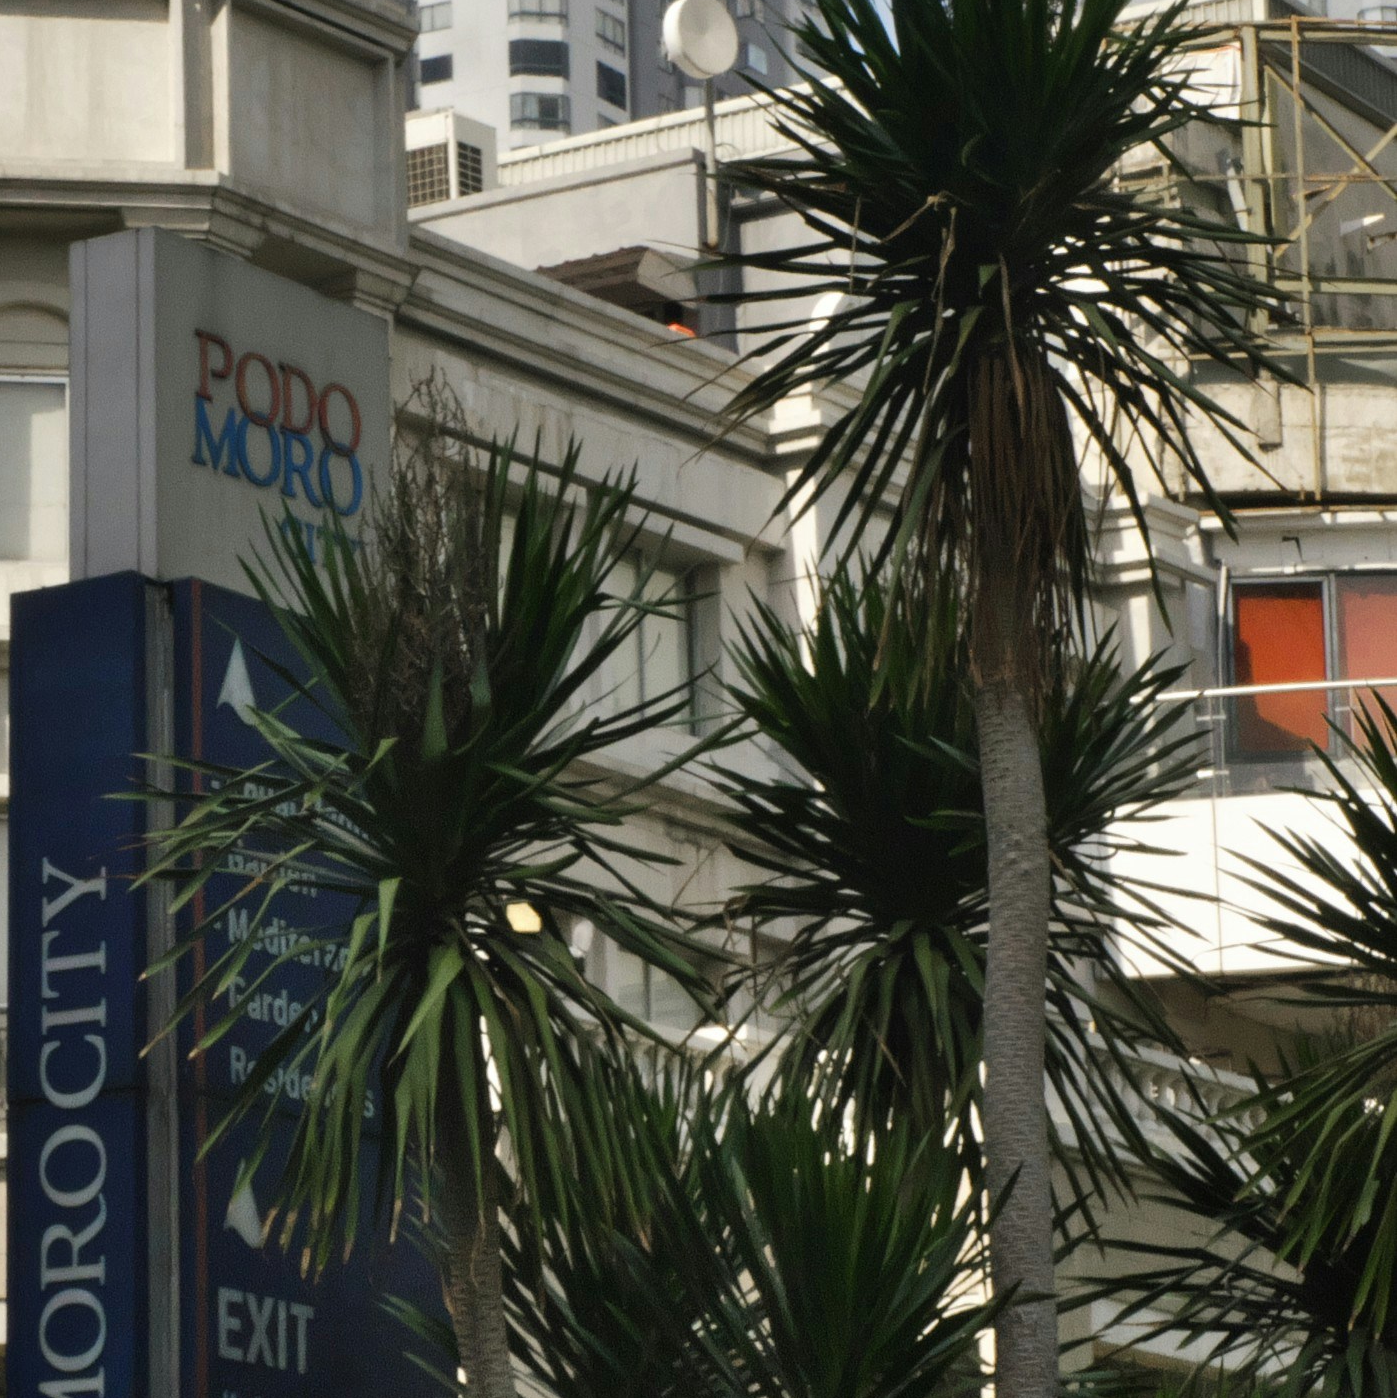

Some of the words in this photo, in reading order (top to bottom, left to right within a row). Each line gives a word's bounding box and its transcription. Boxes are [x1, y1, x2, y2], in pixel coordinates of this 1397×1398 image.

[194, 327, 362, 457] PODO
[191, 393, 364, 517] MORO
[217, 1285, 315, 1376] EXIT
